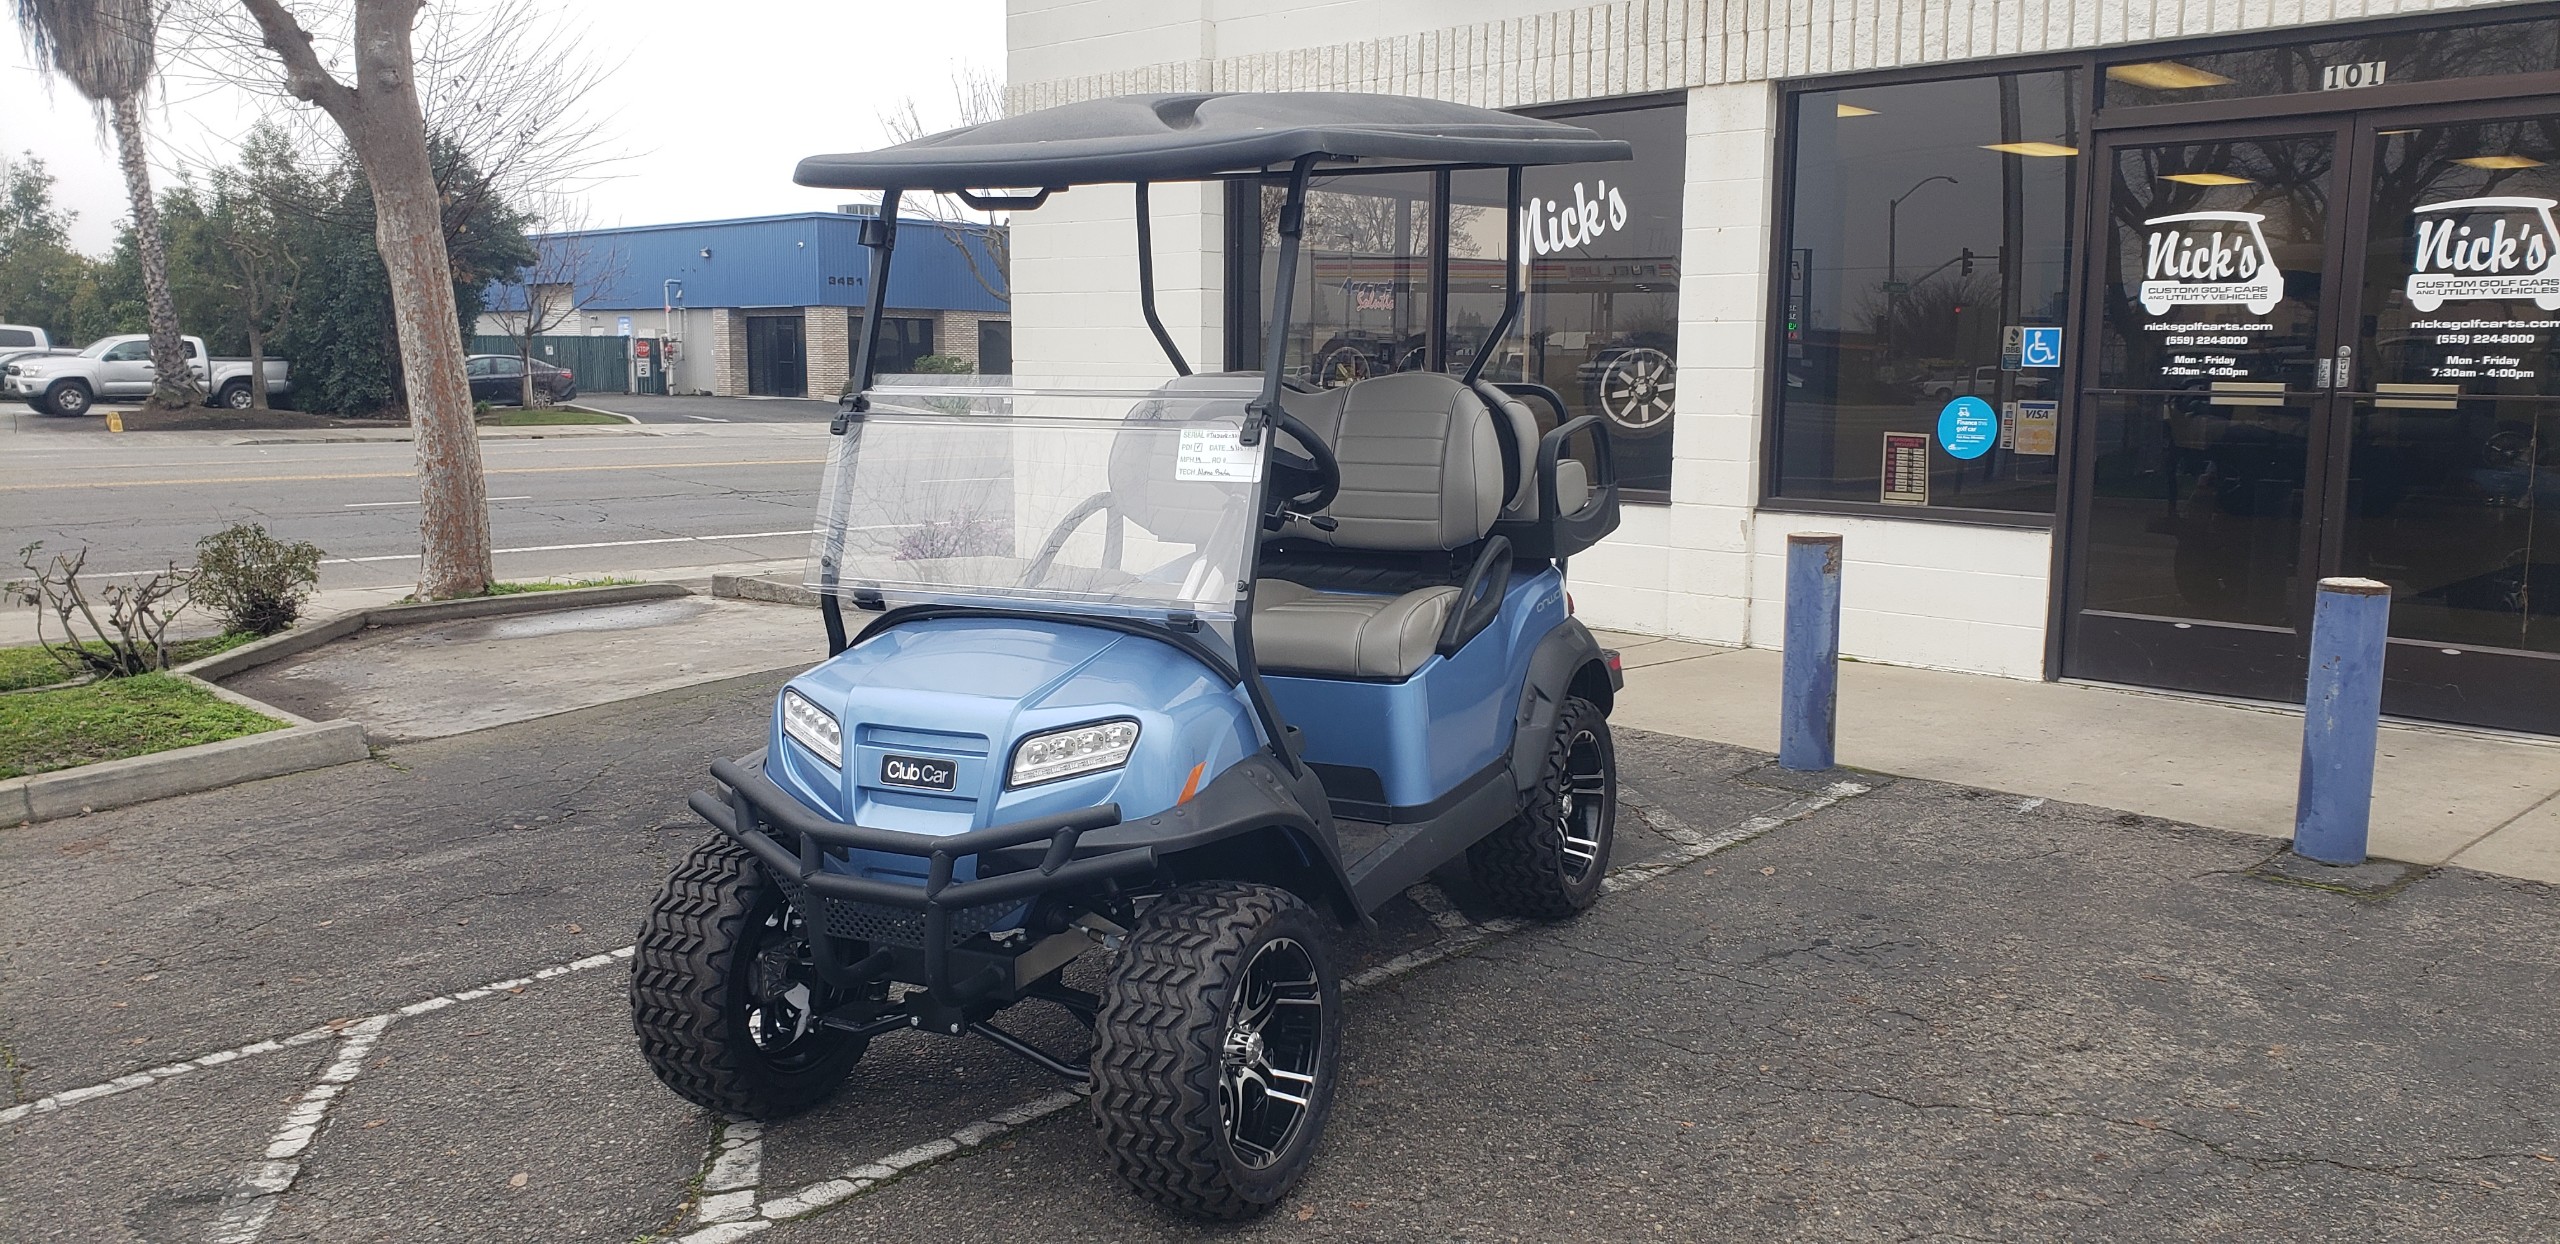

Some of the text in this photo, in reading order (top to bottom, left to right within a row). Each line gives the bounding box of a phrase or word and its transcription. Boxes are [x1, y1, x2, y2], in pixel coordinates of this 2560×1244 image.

[2328, 62, 2379, 89] 101
[1520, 180, 1627, 265] Nick's
[2415, 219, 2547, 273] Nick's
[2147, 230, 2257, 280] Nick's
[2520, 278, 2560, 286] CARS
[2201, 286, 2233, 294] GOLF
[2438, 288, 2489, 296] UTILITY
[2491, 287, 2559, 295] VEHICLES
[2144, 322, 2273, 332] nicksgolfcarts.com
[2411, 319, 2560, 330] nicksgolfcarts.com
[2165, 336, 2248, 346] (559) 224-8000
[2436, 334, 2535, 345] (559) 224-8000
[2174, 356, 2197, 364] Mon
[2204, 356, 2236, 366] Friday
[2446, 356, 2473, 365] Mon
[2482, 355, 2520, 367] Friday
[640, 367, 647, 375] 5
[2161, 367, 2200, 375] 7:30am
[2208, 367, 2248, 377] 4:00pm
[2430, 368, 2476, 377] 7:30am
[2486, 368, 2535, 379] 4:00pm
[2026, 410, 2049, 419] VISA
[887, 761, 948, 784] Club Car
